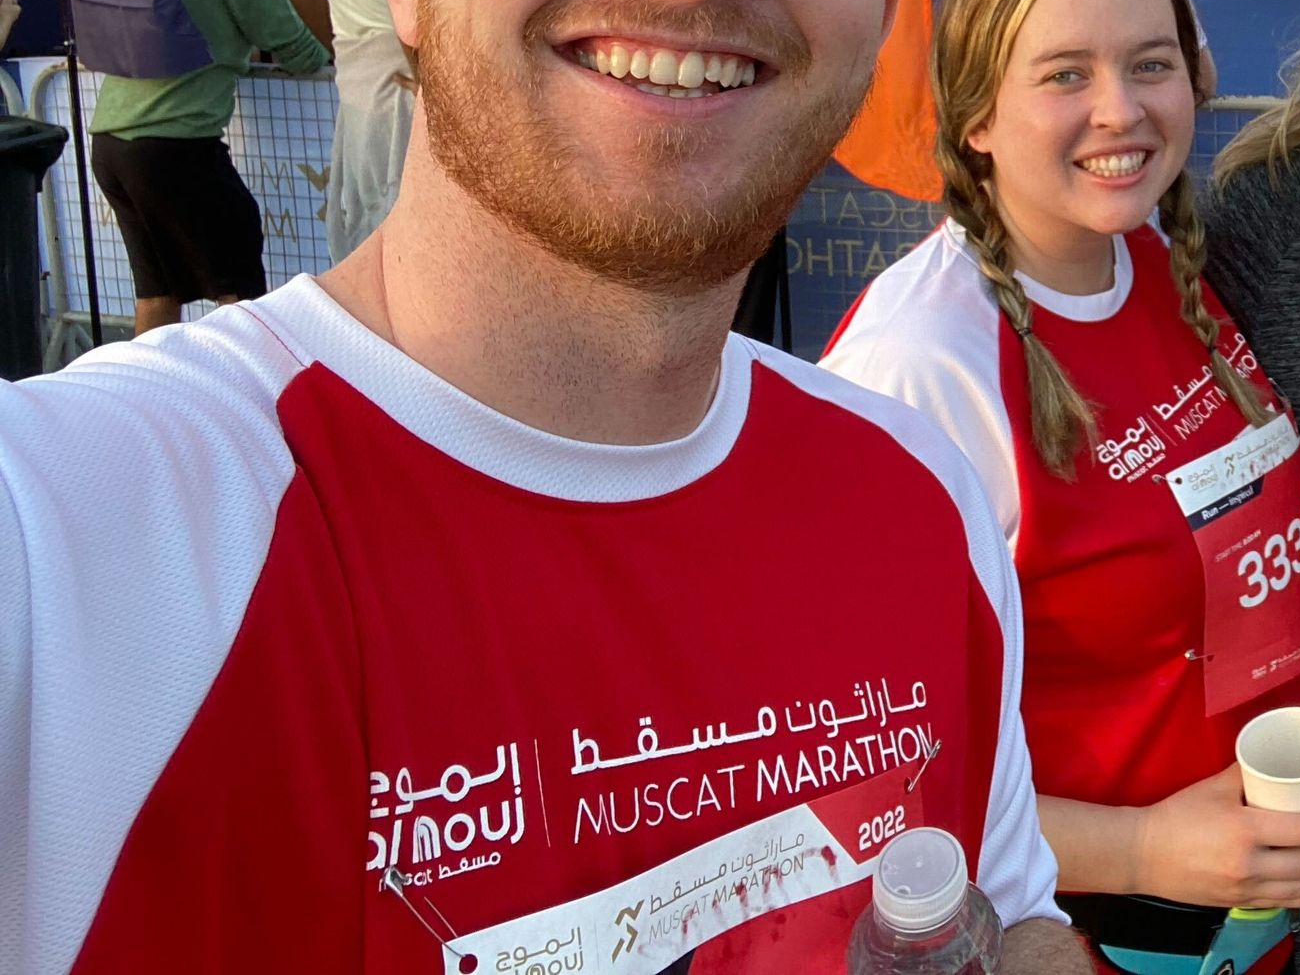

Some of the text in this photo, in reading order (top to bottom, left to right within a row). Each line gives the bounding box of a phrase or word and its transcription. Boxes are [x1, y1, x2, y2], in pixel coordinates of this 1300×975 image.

[1152, 365, 1213, 420] مسقط
[1174, 389, 1221, 441] MUSCAT
[1201, 506, 1219, 520] Run
[571, 677, 927, 775] ماراثون مسقط
[574, 722, 934, 844] MUSCAT MARATHON
[858, 805, 906, 851] 2022
[438, 852, 501, 880] مسقط
[650, 833, 805, 916] ماراثون مسقط
[649, 853, 805, 944] MUSCAT MARATHON
[496, 927, 583, 972] الموج
